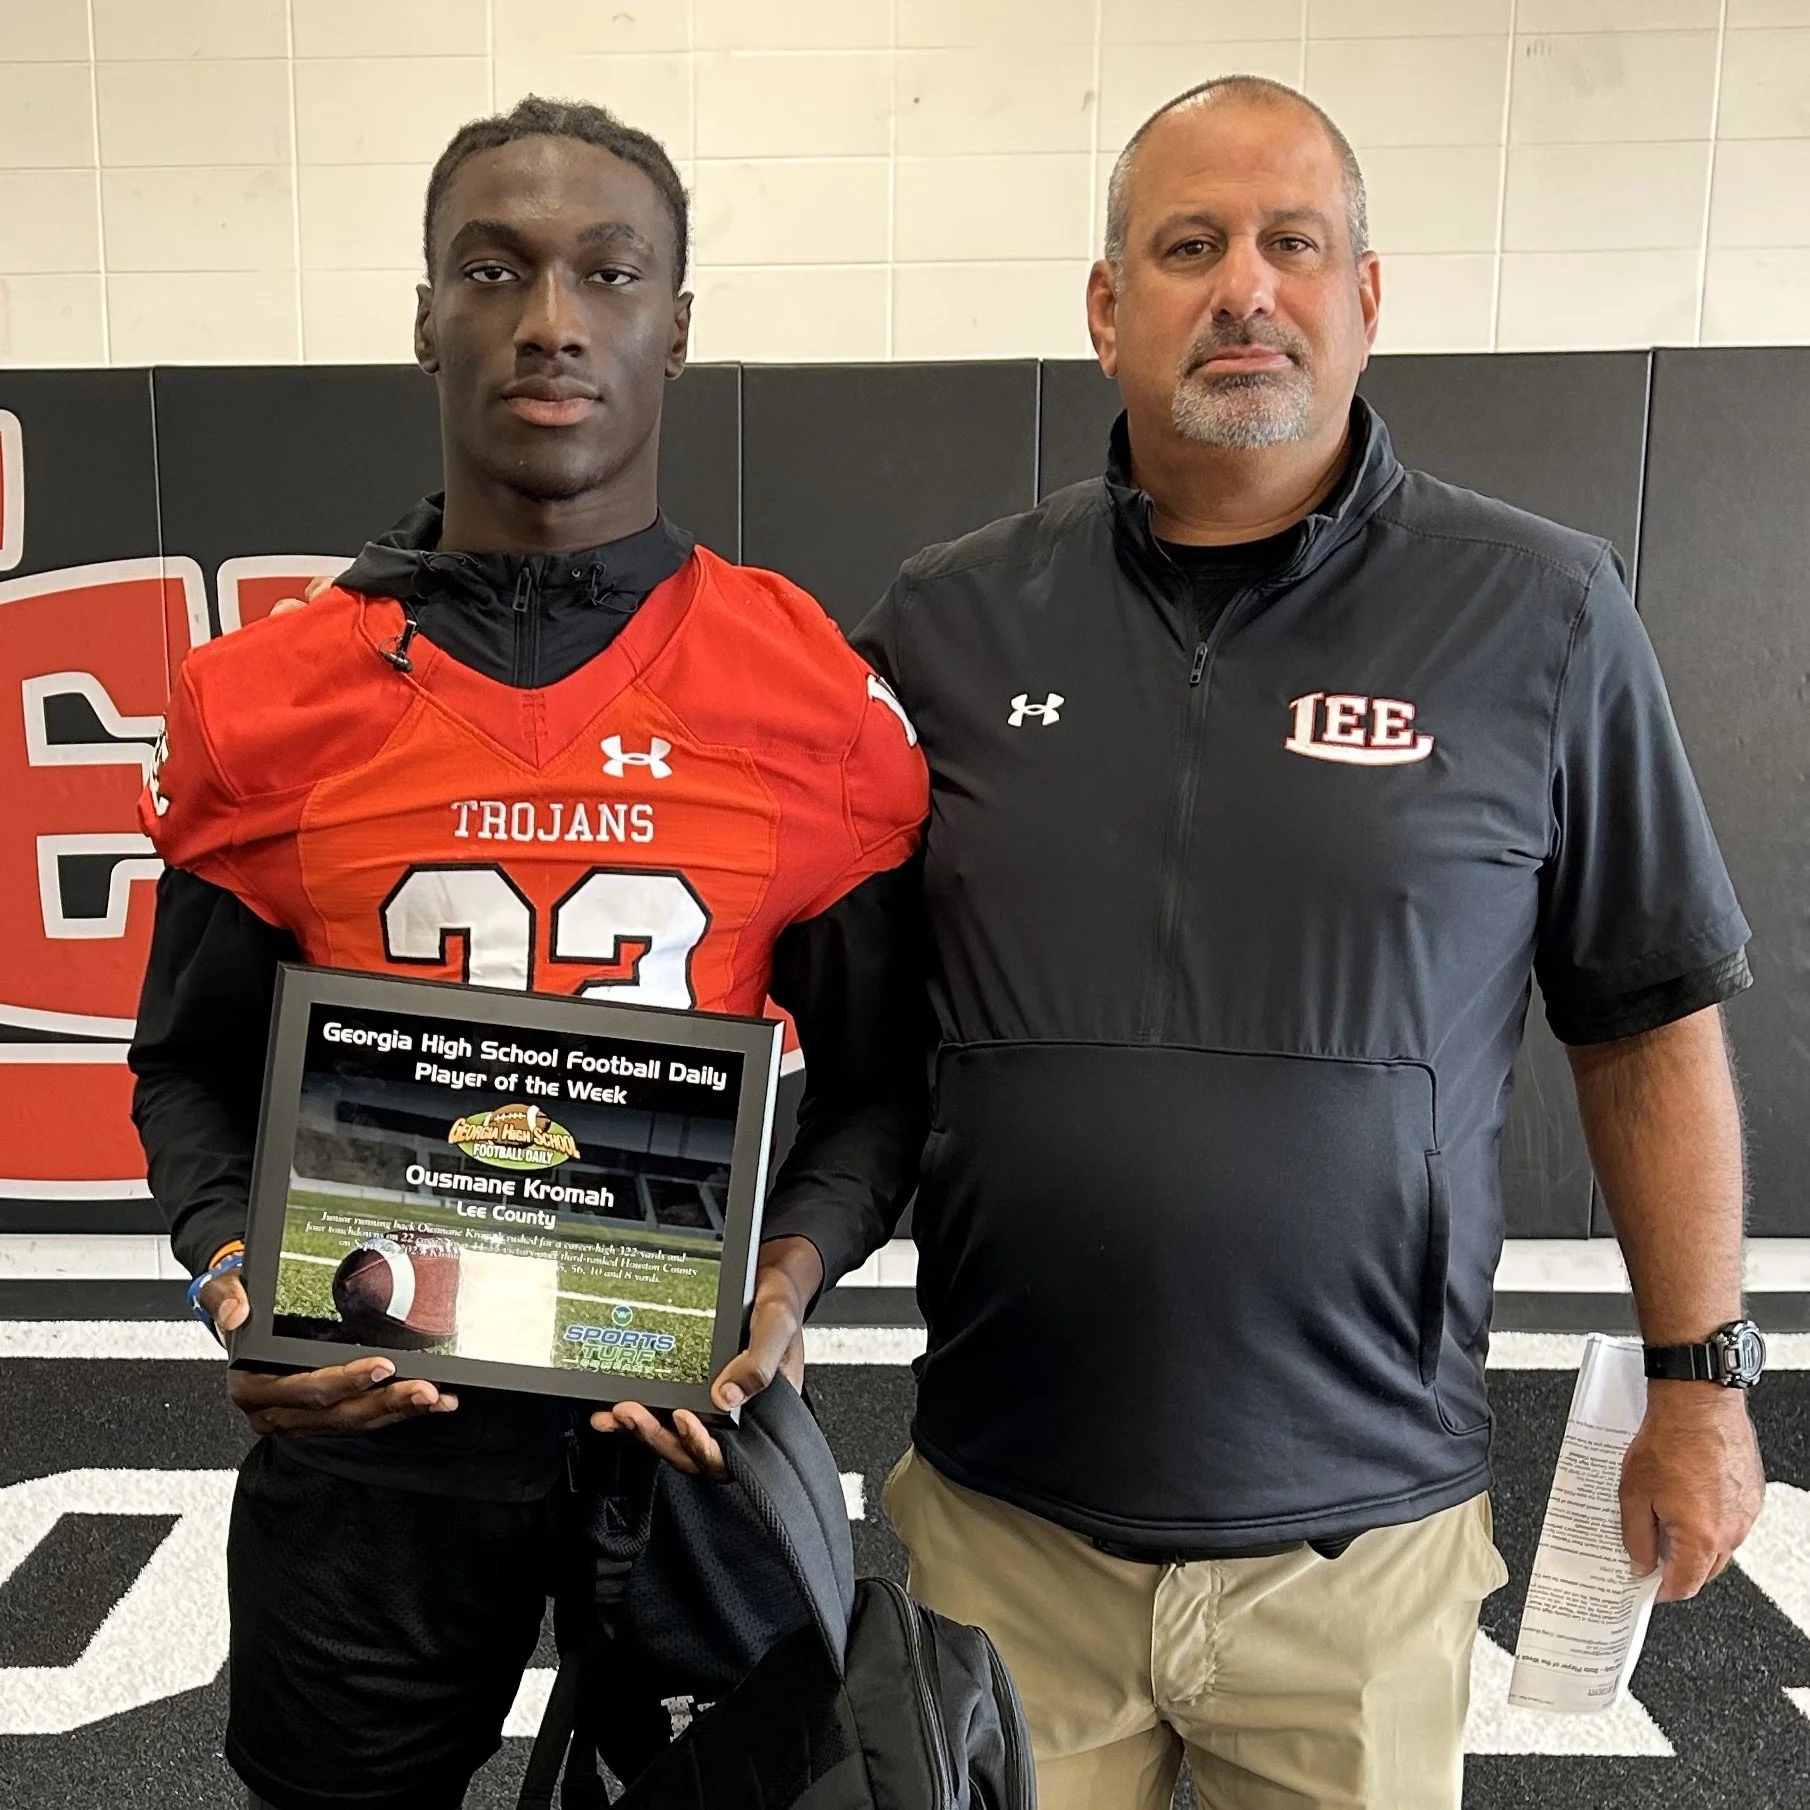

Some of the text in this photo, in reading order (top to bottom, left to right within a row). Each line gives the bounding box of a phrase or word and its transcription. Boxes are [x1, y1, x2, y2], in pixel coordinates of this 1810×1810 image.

[1284, 691, 1435, 767] LEE
[451, 800, 655, 843] TROJANS
[323, 1022, 728, 1091] Georgia High School Football Daily
[414, 1061, 628, 1105] Player of the Week
[473, 1142, 555, 1165] FOOTBALL DAILY
[406, 1164, 615, 1208] Ousmane Kromah
[456, 1200, 557, 1230] Lee County
[305, 1220, 326, 1234] four
[328, 1224, 384, 1240] touchdowns
[400, 1232, 415, 1244] 22
[620, 1257, 660, 1272] Houston
[662, 1262, 698, 1278] County
[321, 1211, 352, 1225] Junior
[354, 1215, 391, 1230] running
[393, 1219, 415, 1231] back
[417, 1222, 464, 1237] Ousmane
[538, 1236, 553, 1248] for
[667, 1252, 687, 1263] and
[604, 1268, 623, 1280] and
[564, 1324, 676, 1352] SPORTS
[581, 1343, 656, 1364] TURF
